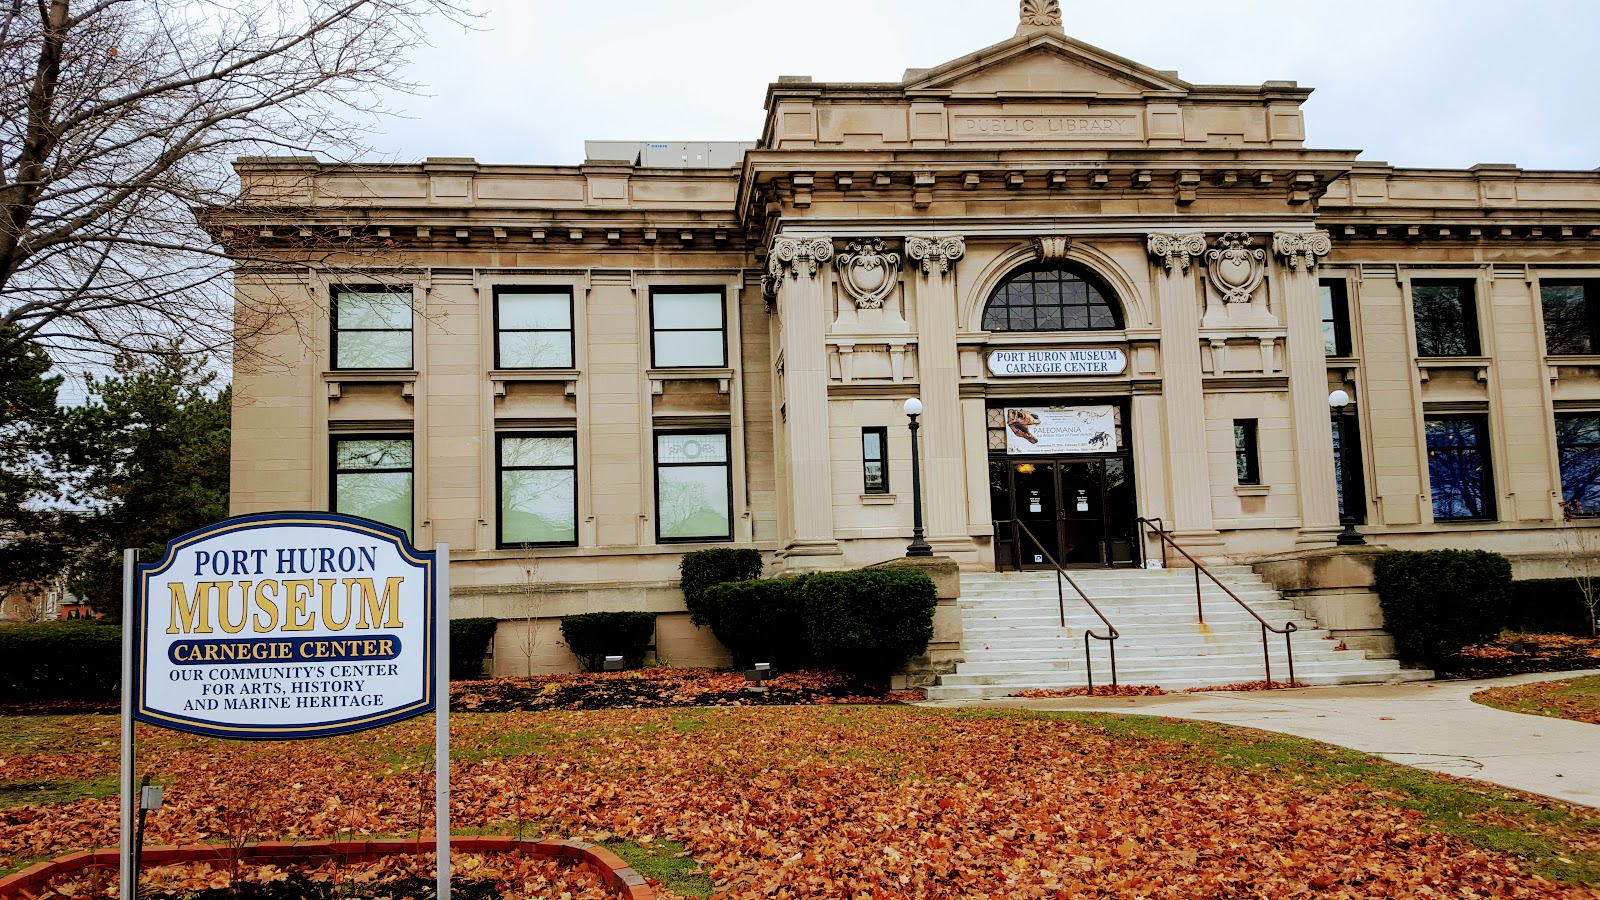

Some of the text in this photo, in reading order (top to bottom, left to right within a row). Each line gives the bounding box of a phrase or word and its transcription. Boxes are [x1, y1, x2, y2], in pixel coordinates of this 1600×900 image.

[966, 119, 1126, 132] PUBLIC LIBRARY
[997, 350, 1118, 362] PORT HURON MUSEUM
[1006, 362, 1108, 373] CARNEGIE CENTER
[1033, 426, 1082, 434] PALEOMANIA
[194, 546, 378, 576] PORT HURON
[166, 577, 404, 634] MUSEUM
[173, 639, 395, 662] CARNEGIE CENTER
[169, 664, 399, 682] OUR COMMUNITY'S CENTER
[201, 679, 366, 697] FOR ARTS, HISTORY
[183, 694, 384, 711] AND MARINE HERITAGE
